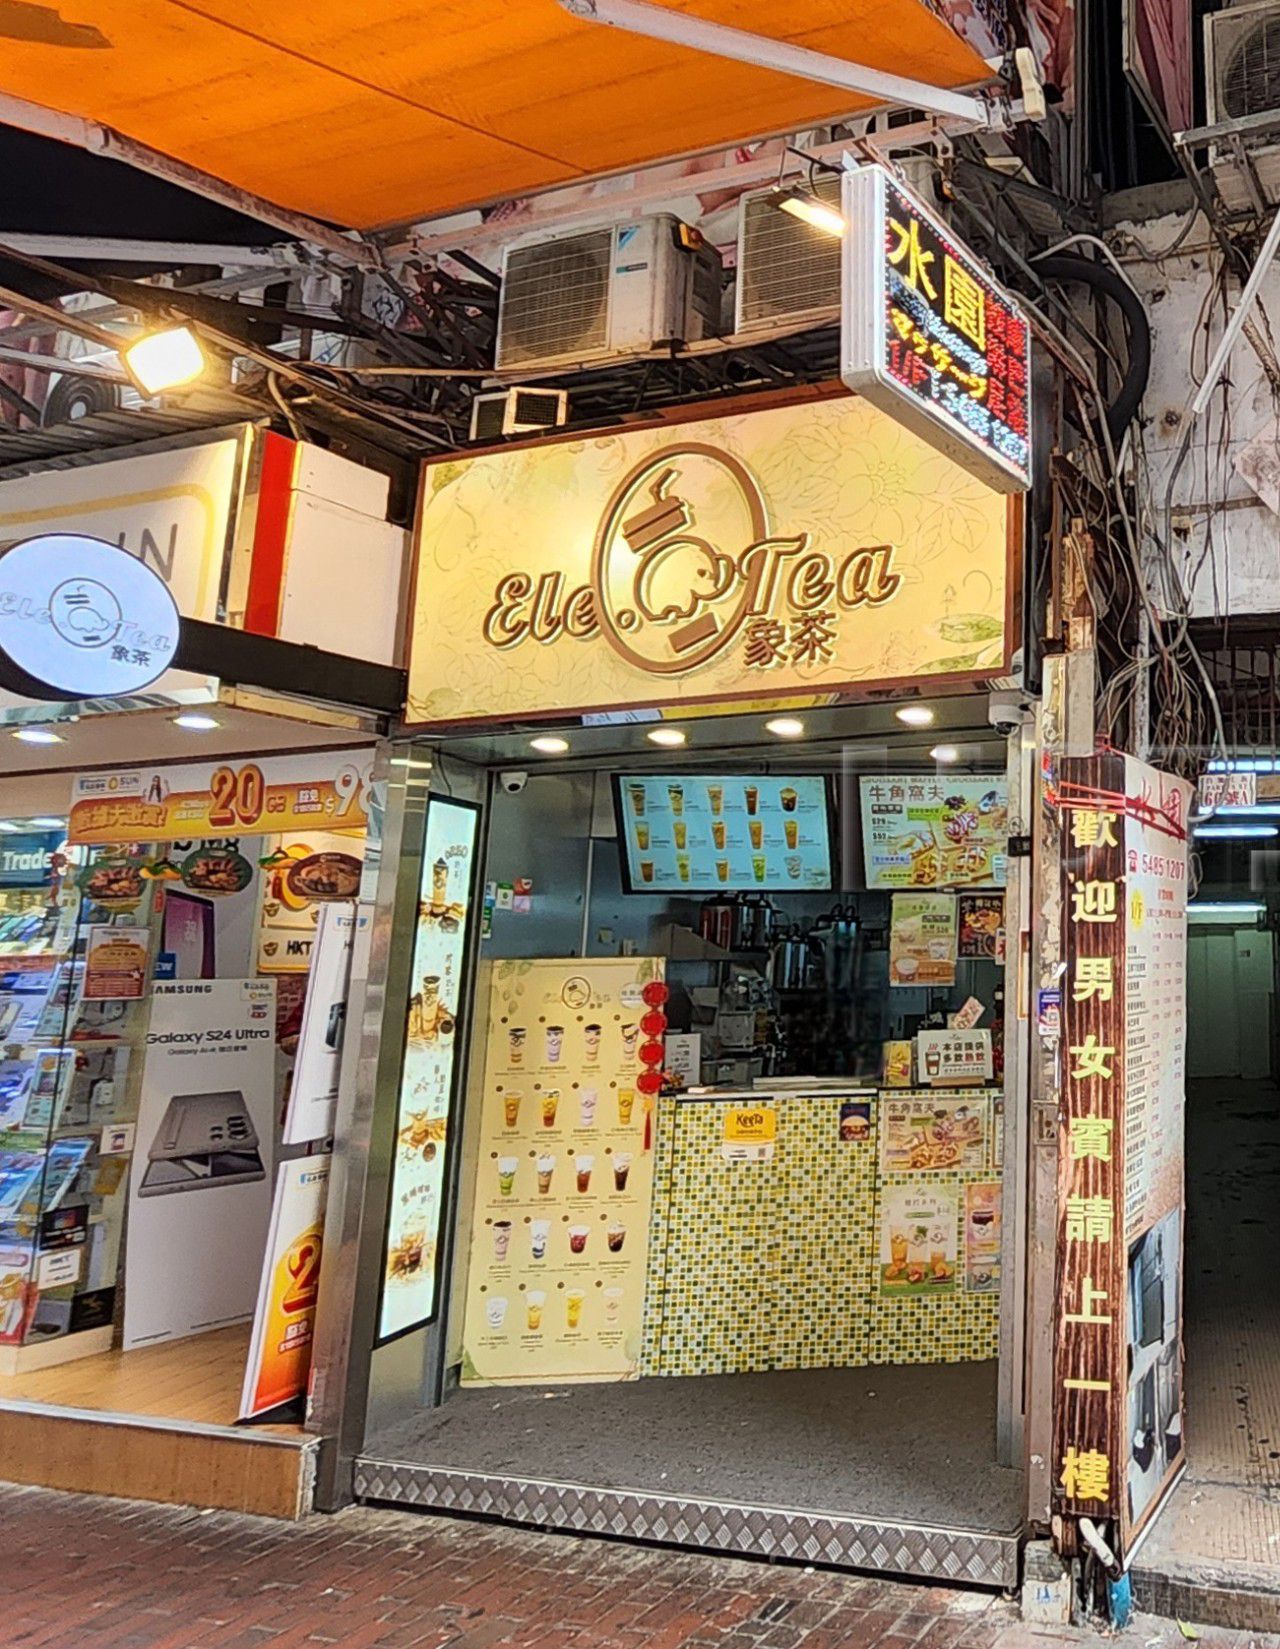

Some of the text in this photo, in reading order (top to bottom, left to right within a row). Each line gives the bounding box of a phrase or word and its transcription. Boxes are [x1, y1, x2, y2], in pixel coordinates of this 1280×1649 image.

[887, 218, 986, 352] 水園
[733, 532, 900, 616] Tea
[743, 610, 837, 668] 象茶
[208, 764, 265, 828] 20
[152, 984, 213, 994] AMSUNG
[205, 1030, 232, 1041] S24
[235, 1028, 270, 1040] Ultra
